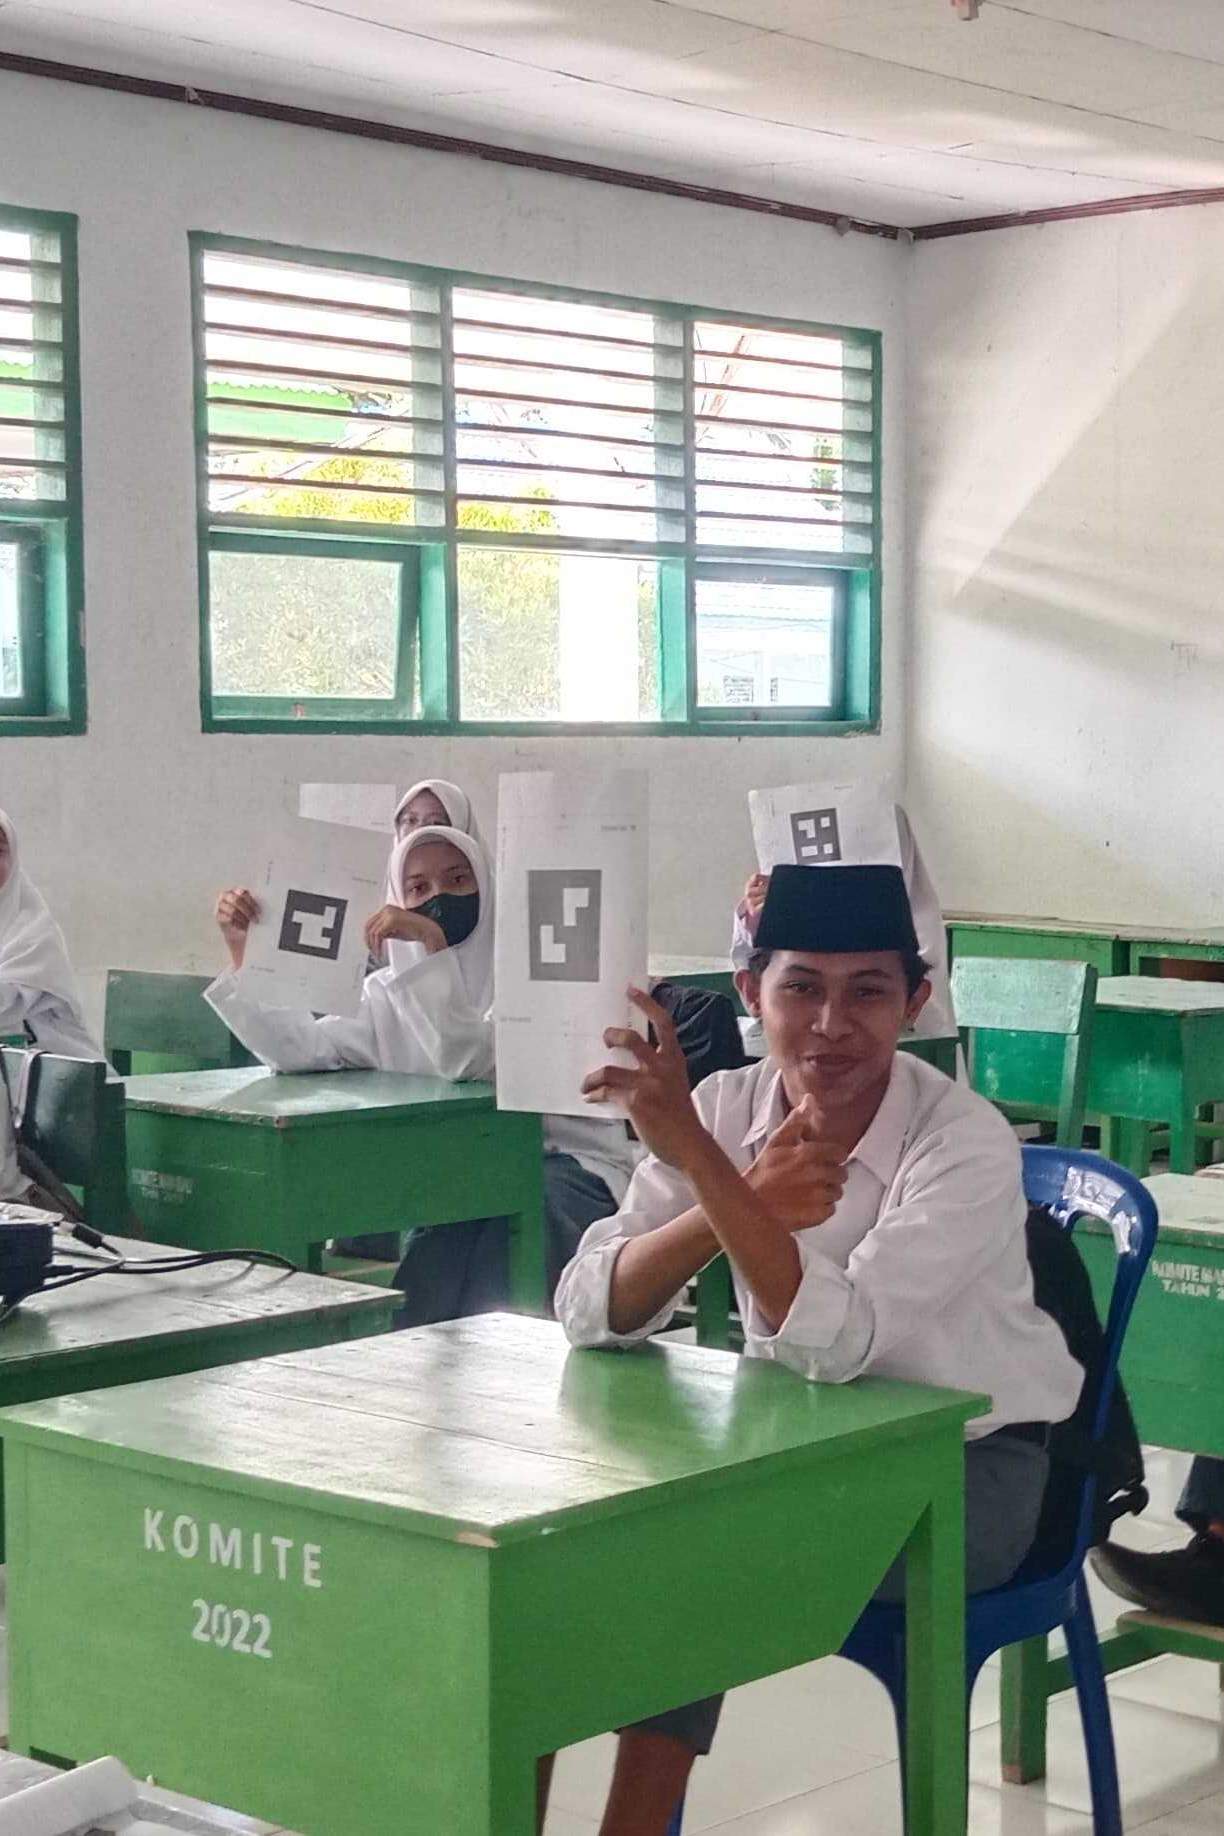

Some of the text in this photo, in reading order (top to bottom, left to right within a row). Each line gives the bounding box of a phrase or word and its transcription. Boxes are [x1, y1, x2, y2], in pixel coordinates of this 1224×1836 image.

[1162, 1279, 1210, 1297] TAHUN
[144, 1508, 322, 1588] KOMITE
[191, 1598, 272, 1658] 2022
